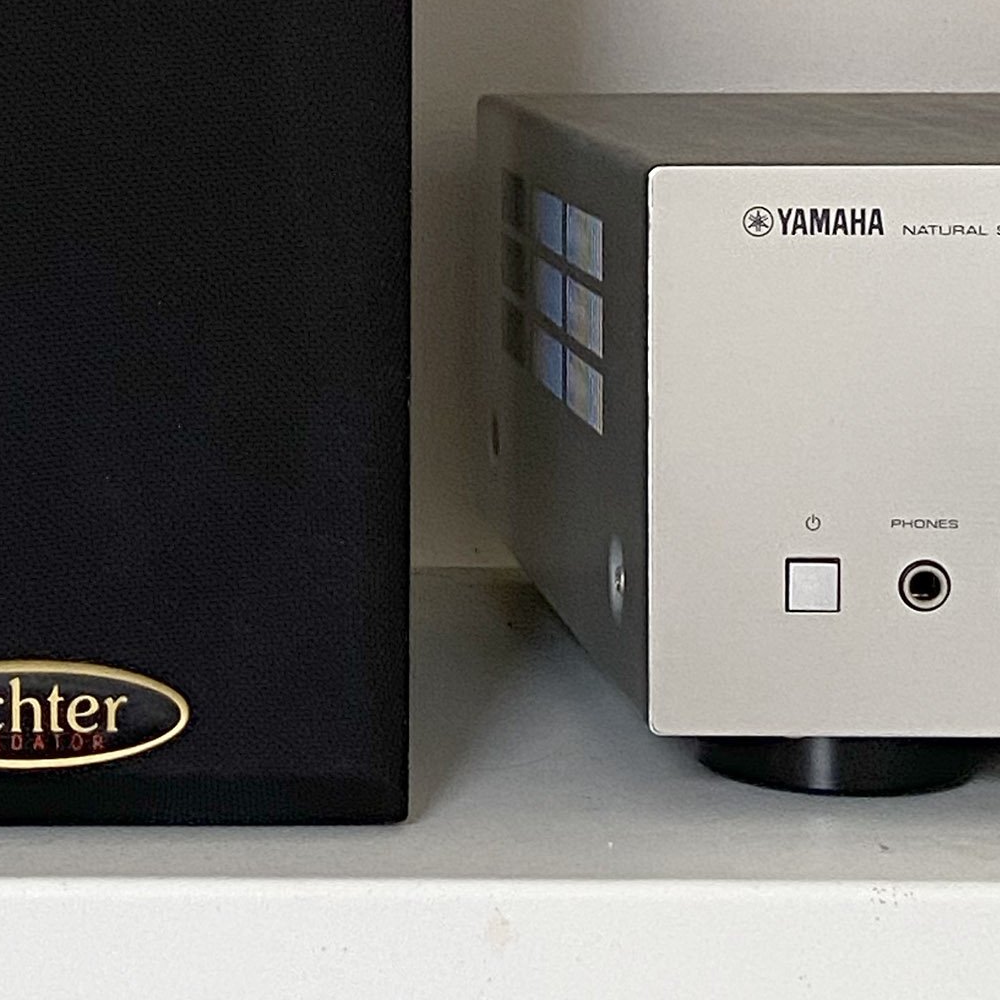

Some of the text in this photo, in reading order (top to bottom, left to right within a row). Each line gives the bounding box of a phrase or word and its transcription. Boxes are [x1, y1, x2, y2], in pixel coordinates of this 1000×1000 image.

[777, 208, 884, 236] YAMAHA
[902, 224, 989, 236] NATURAL
[890, 518, 960, 529] PHONES
